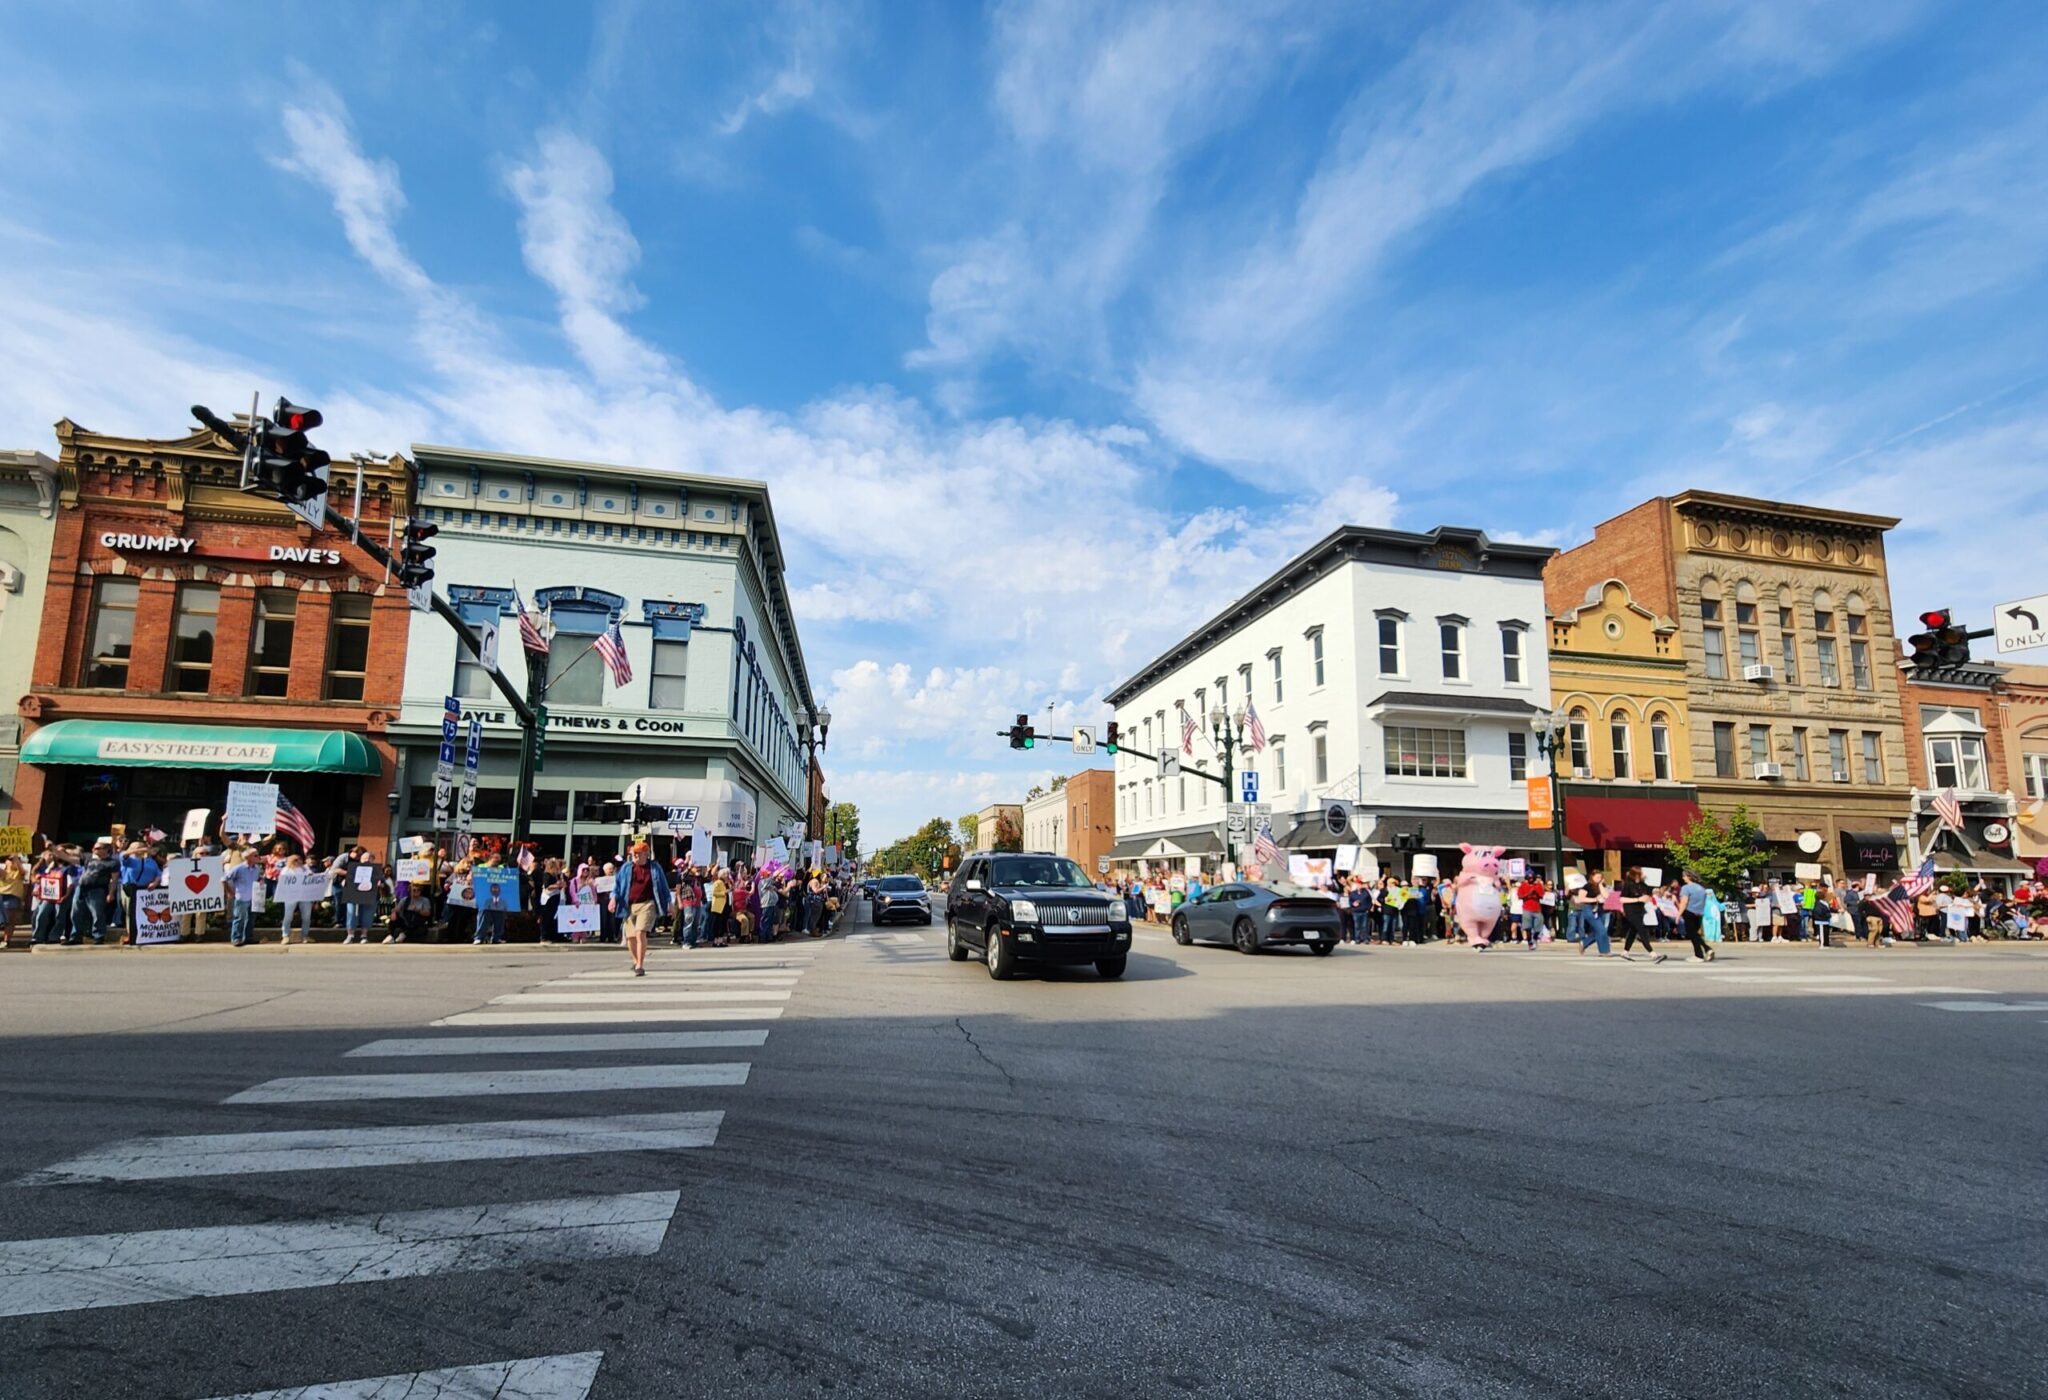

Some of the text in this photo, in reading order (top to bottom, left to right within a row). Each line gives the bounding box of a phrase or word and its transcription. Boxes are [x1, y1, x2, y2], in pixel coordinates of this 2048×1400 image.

[101, 532, 195, 553] GRUMPY
[269, 545, 340, 565] DAVE'S
[412, 590, 428, 605] ONLY
[2005, 632, 2046, 648] ONLY
[444, 721, 456, 738] 75
[618, 719, 628, 730] &
[470, 722, 480, 750] H
[106, 741, 270, 759] EASYSTREET CAFE
[1244, 772, 1258, 790] H
[437, 784, 450, 802] 64
[463, 789, 474, 806] 64
[1230, 816, 1244, 827] 25
[1256, 816, 1270, 828] 25
[190, 858, 202, 873] I
[140, 894, 154, 902] THE
[171, 897, 221, 913] AMERICA
[140, 921, 180, 931] MONARCH
[156, 929, 179, 938] NEED
